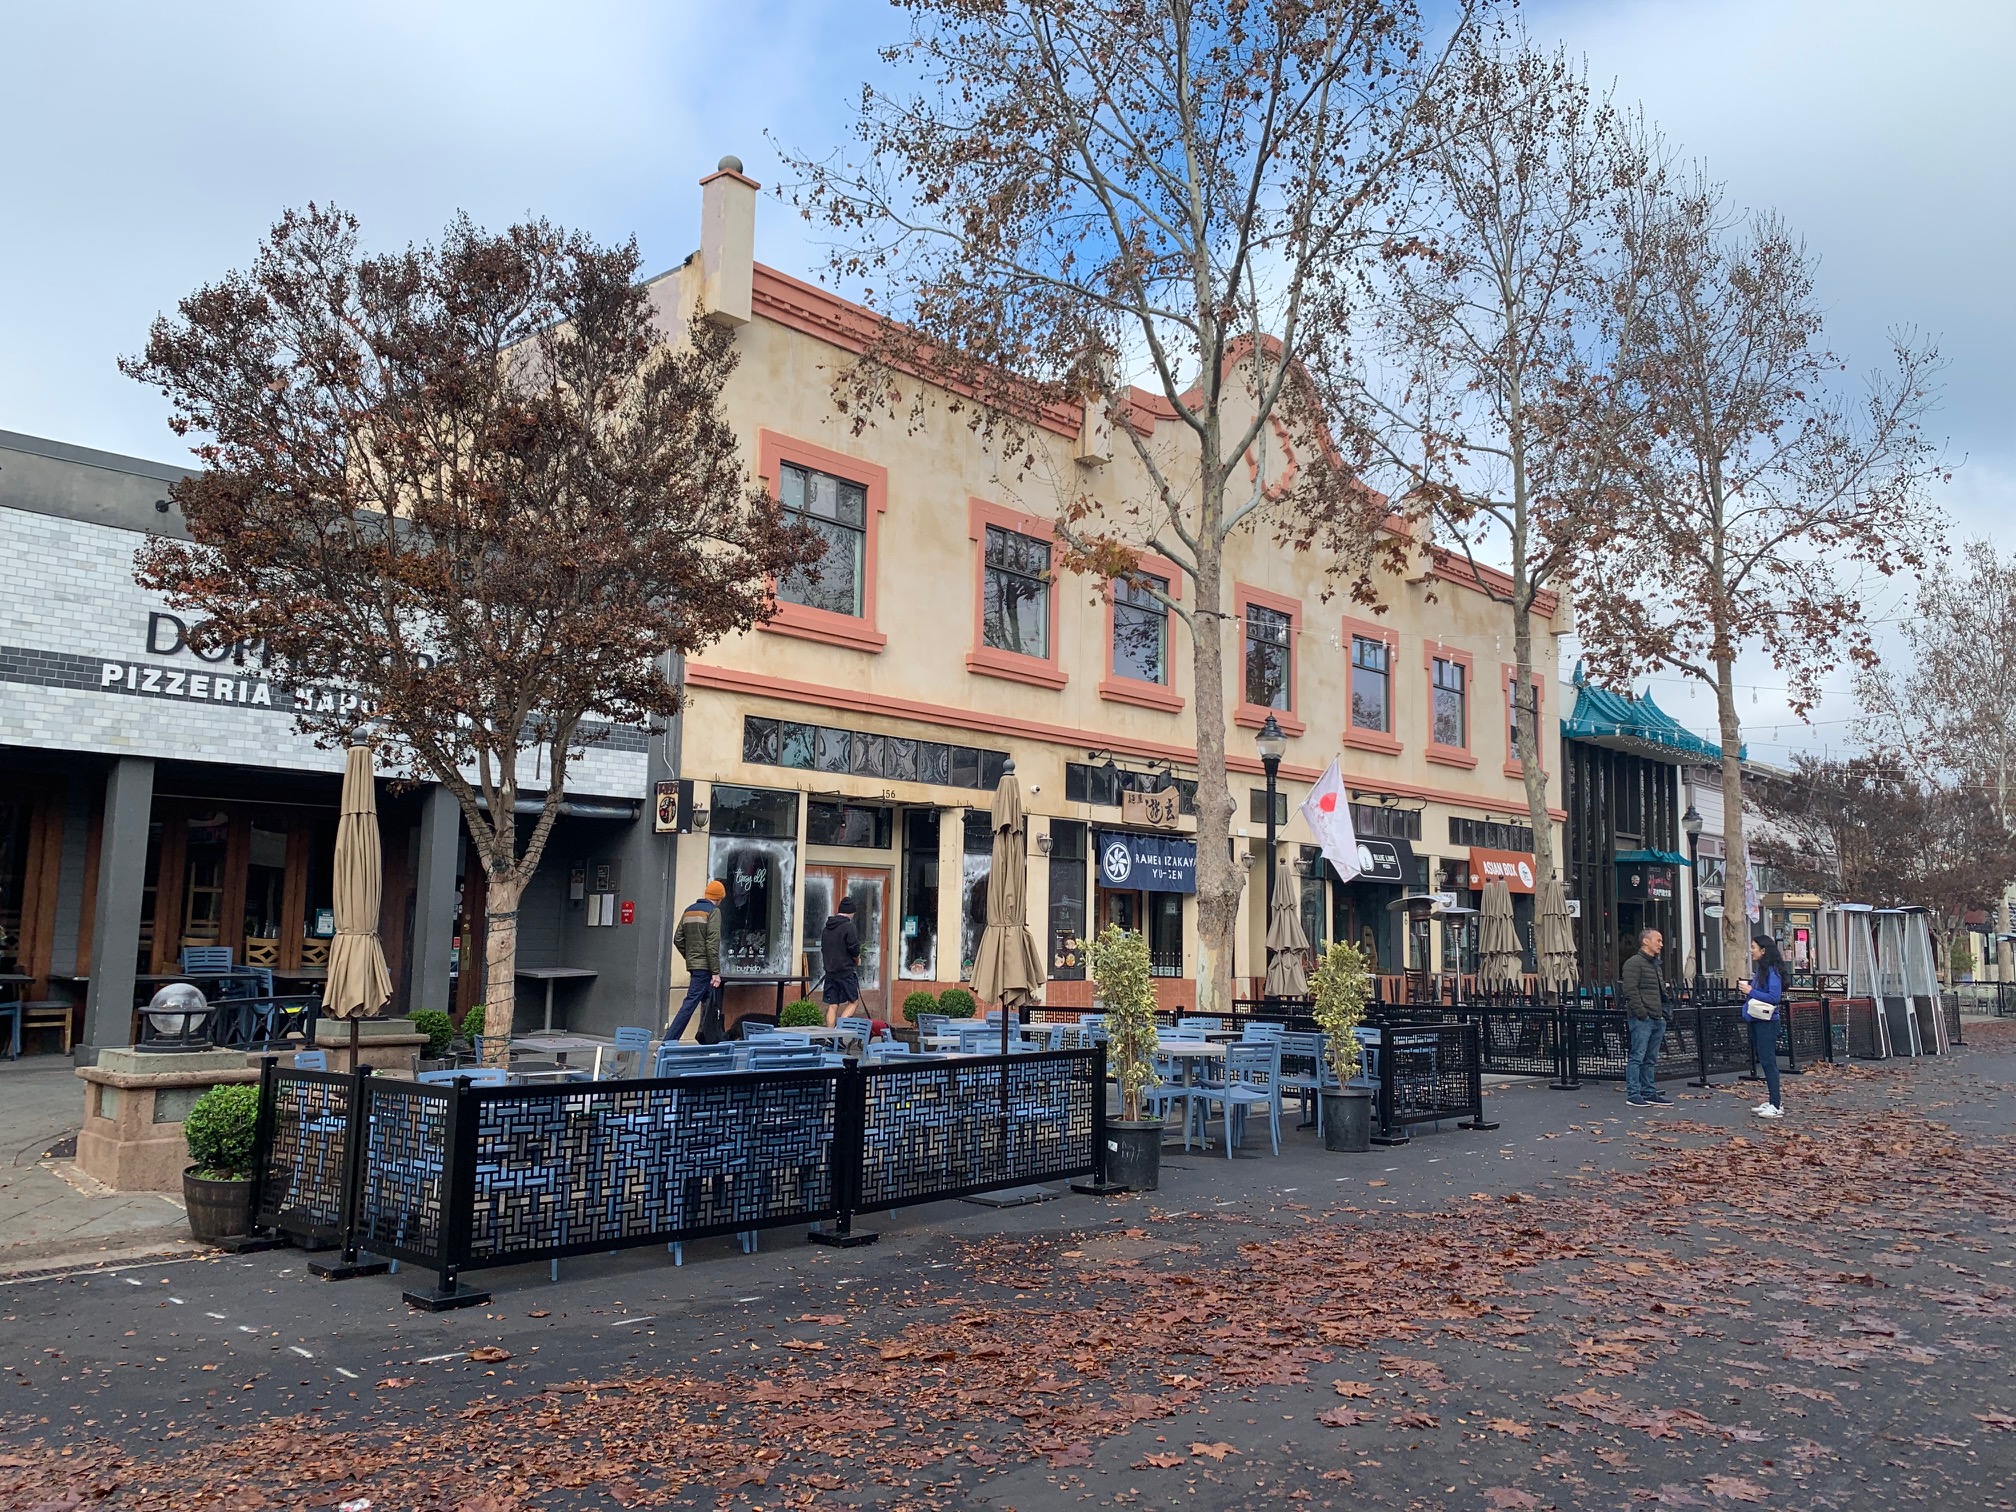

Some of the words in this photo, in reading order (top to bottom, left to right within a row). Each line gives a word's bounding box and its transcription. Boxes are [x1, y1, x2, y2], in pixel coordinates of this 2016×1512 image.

[101, 663, 272, 706] PIZZERIA
[882, 789, 896, 799] 156
[1483, 860, 1504, 876] ASIAN
[1502, 862, 1518, 877] BOX
